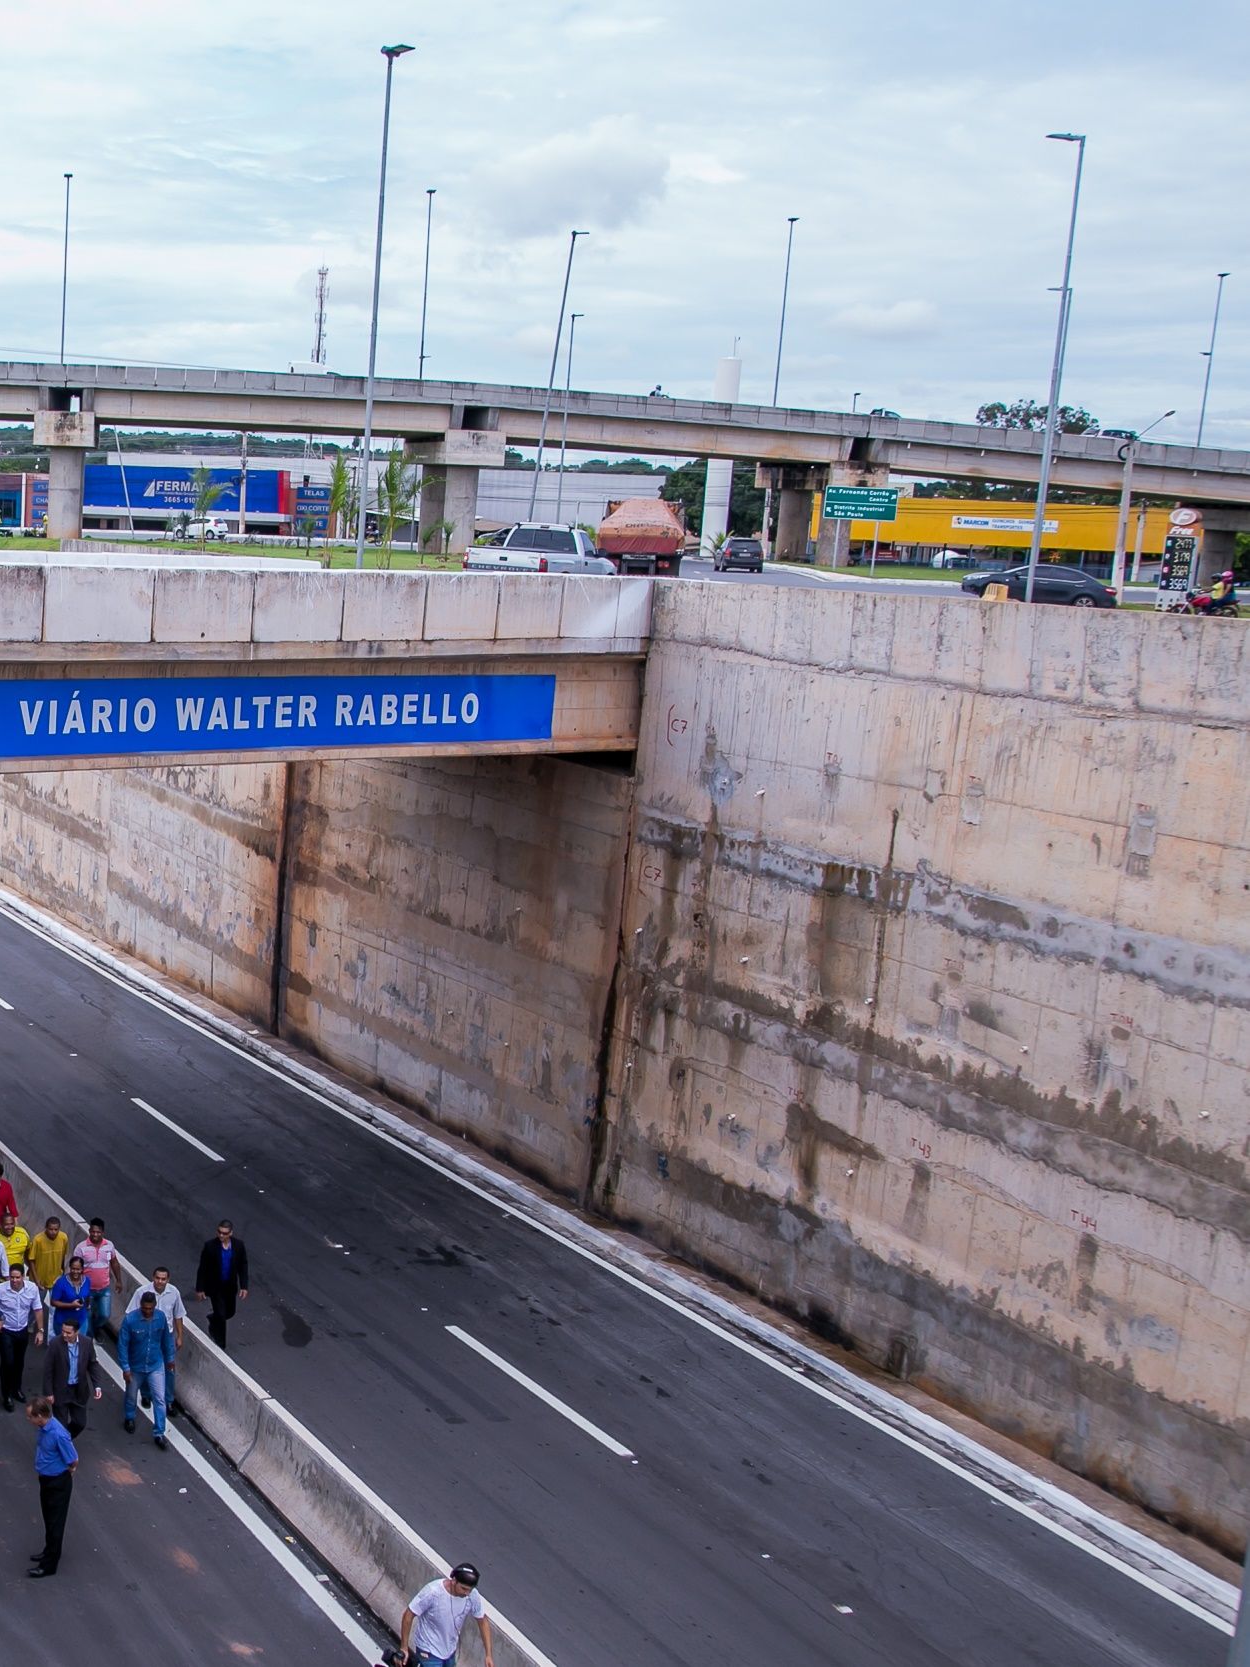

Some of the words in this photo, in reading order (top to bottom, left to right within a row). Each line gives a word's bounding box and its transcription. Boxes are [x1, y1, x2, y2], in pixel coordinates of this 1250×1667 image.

[1169, 526, 1194, 535] Free
[471, 564, 536, 572] CHEVROLET
[1168, 578, 1188, 589] 3569
[19, 690, 157, 735] VIÁRIO
[175, 695, 318, 731] WALTER
[334, 692, 480, 726] RABELLO
